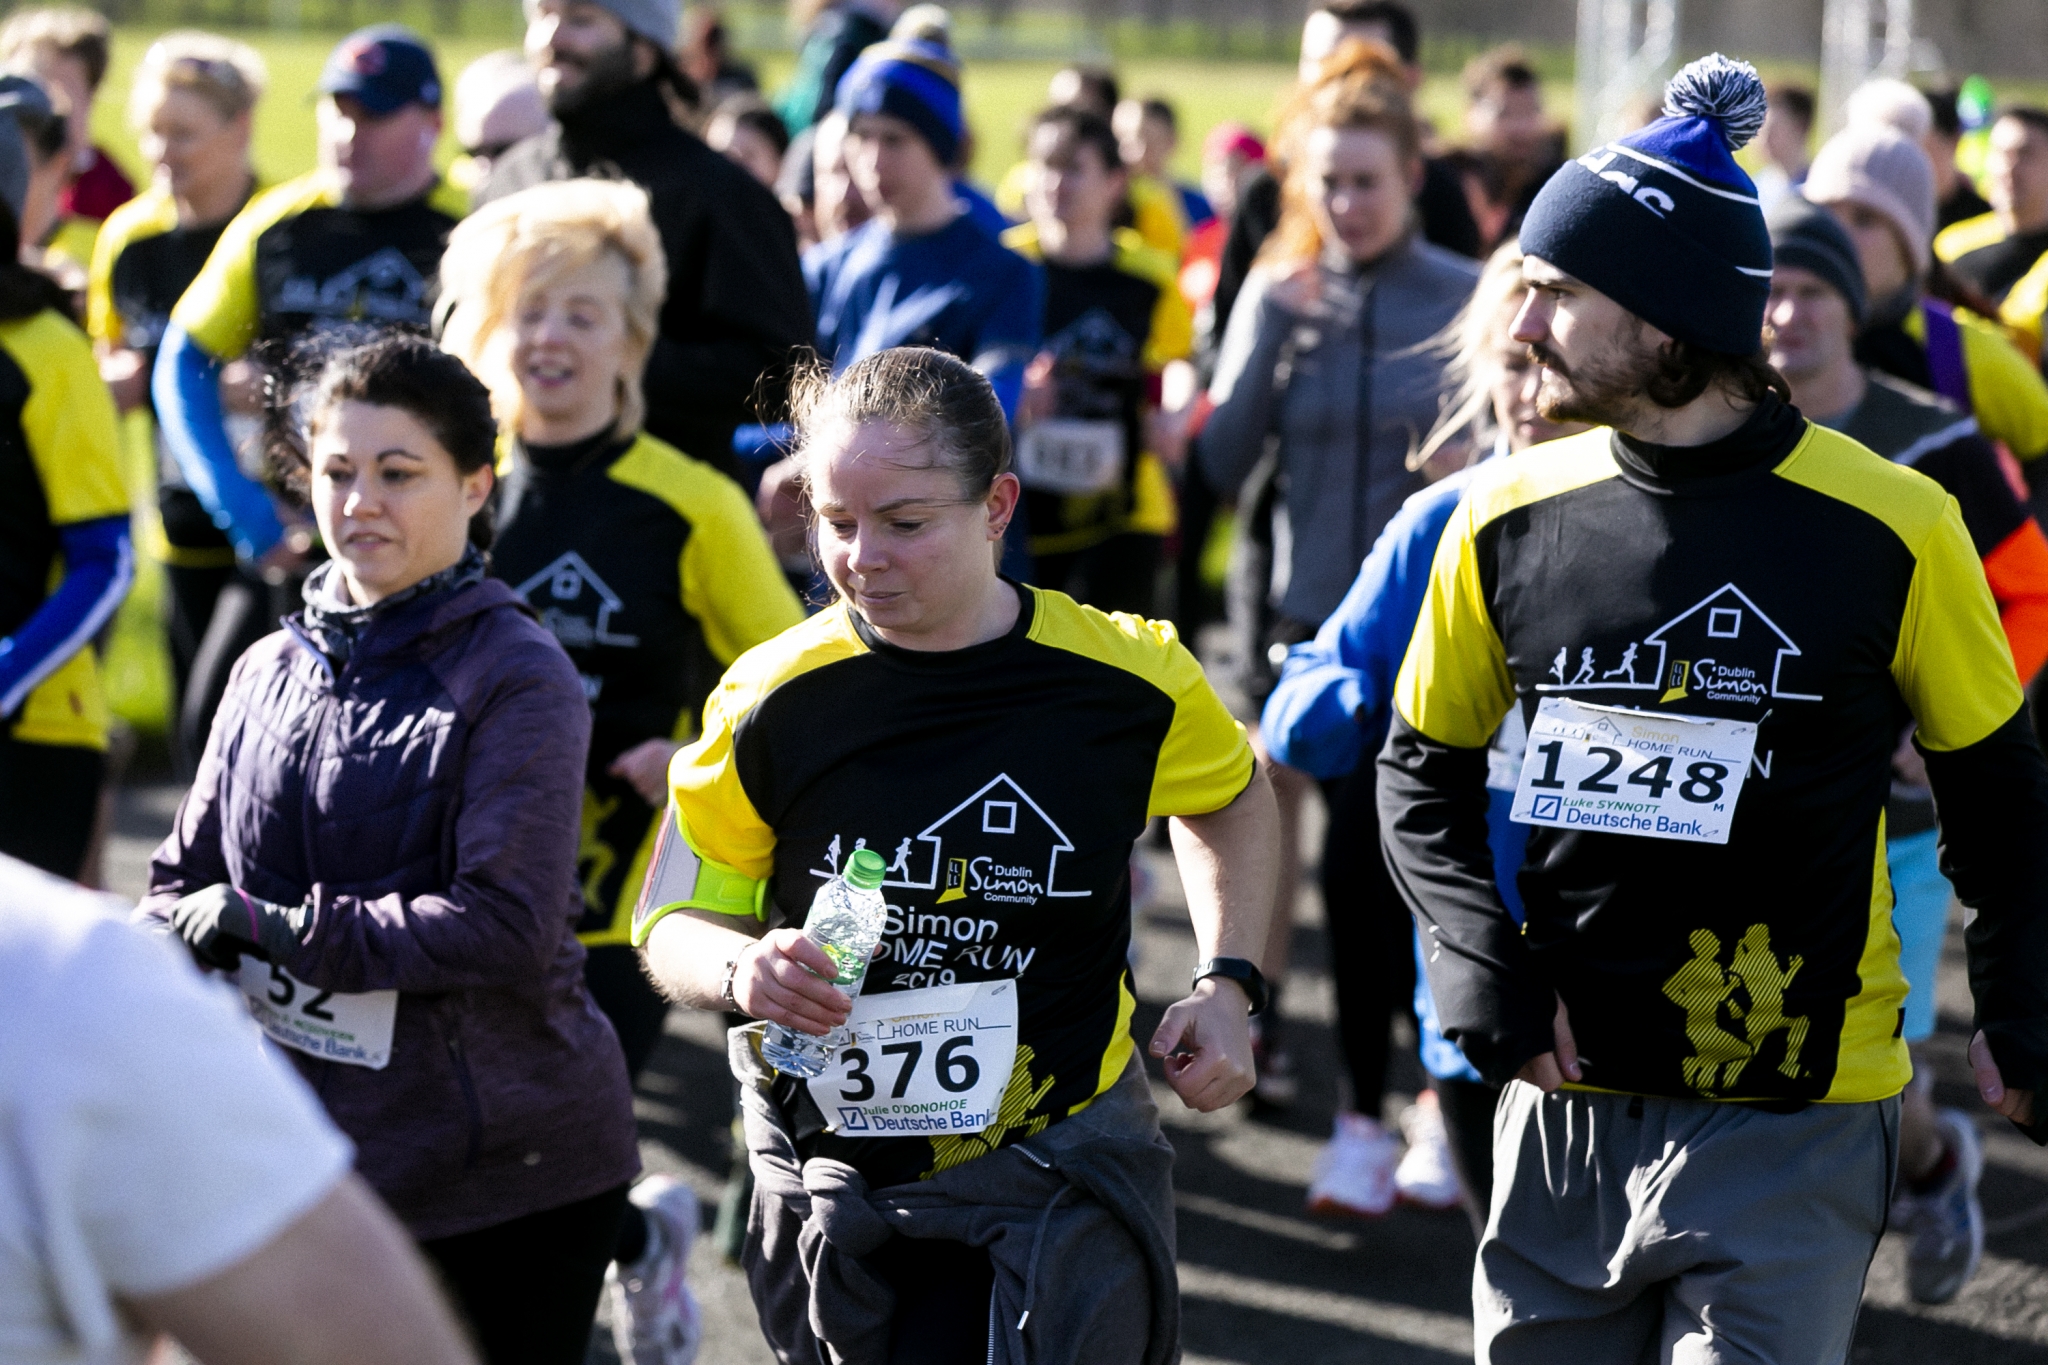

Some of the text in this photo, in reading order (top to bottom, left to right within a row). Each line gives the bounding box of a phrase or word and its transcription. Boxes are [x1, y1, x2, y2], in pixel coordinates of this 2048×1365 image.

[1693, 658, 1767, 695] Simon
[1718, 666, 1756, 678] Dublin
[1706, 690, 1761, 705] Community
[1631, 726, 1680, 744] Simon
[1626, 739, 1713, 759] HOME RUN
[1531, 740, 1729, 804] 1248
[1562, 797, 1661, 814] Luke SYNNOTT
[1713, 803, 1724, 812] M
[1566, 808, 1702, 836] Deutsche Bank
[969, 856, 1044, 895] Simon
[995, 865, 1032, 878] Dublin
[983, 892, 1037, 906] Community
[884, 904, 999, 943] Simon
[953, 944, 1036, 973] RUN
[892, 1020, 939, 1038] HOME
[944, 1017, 980, 1032] RUN
[839, 1035, 980, 1103] 376
[891, 1099, 967, 1114] O'DONOHOE
[872, 1113, 947, 1131] Deutsche
